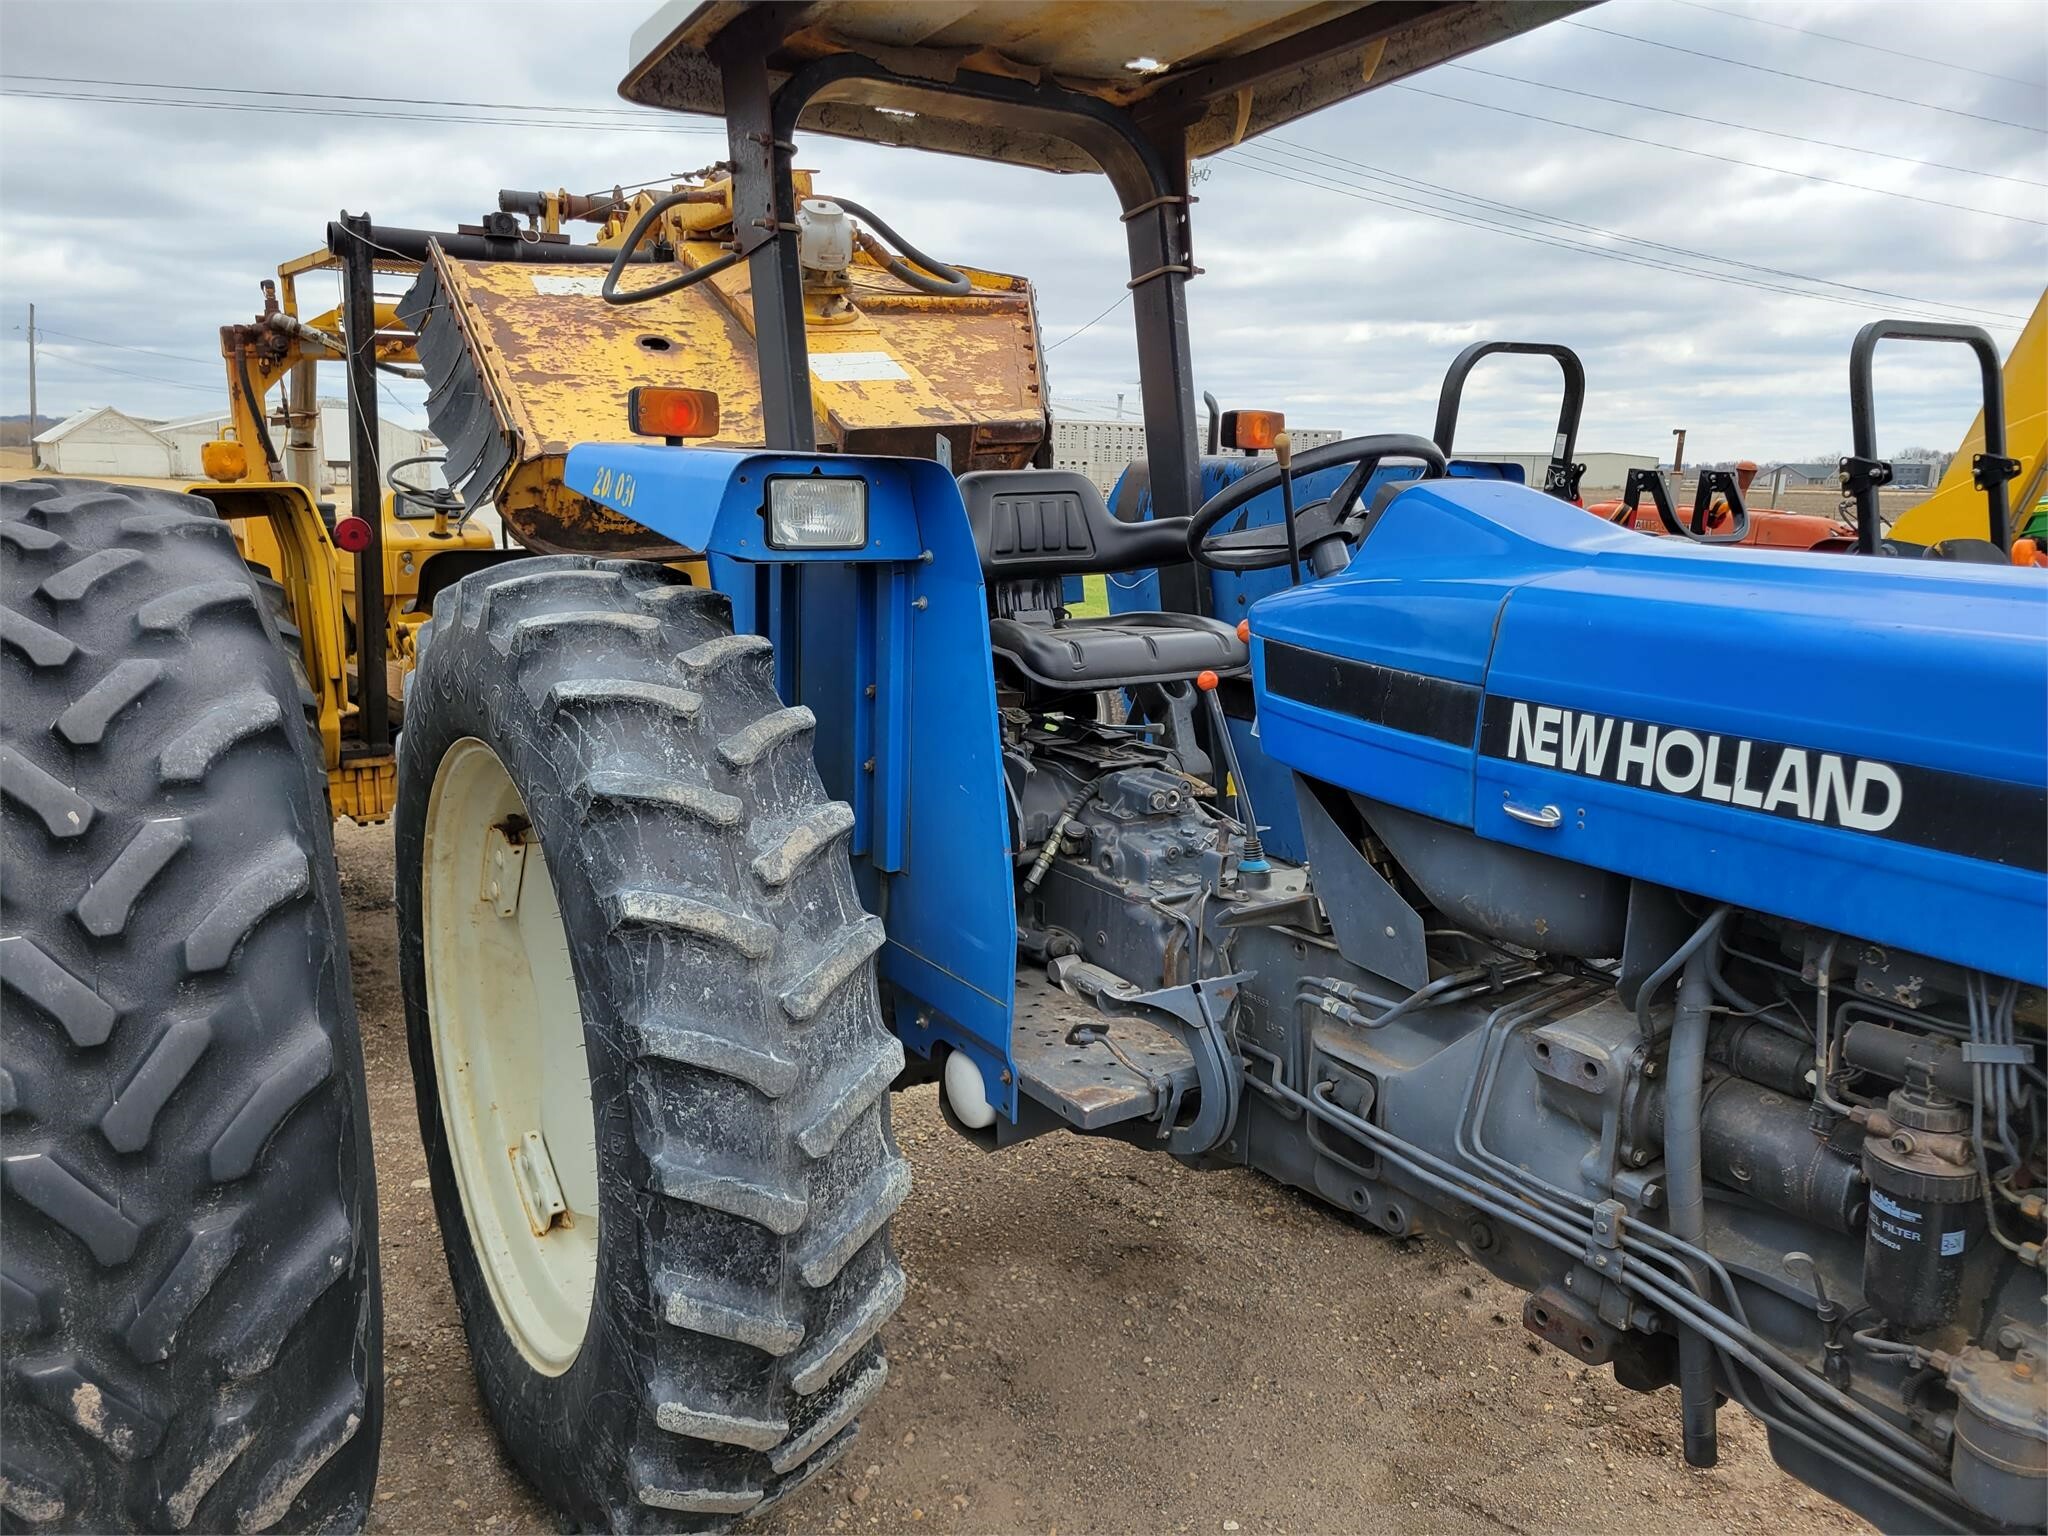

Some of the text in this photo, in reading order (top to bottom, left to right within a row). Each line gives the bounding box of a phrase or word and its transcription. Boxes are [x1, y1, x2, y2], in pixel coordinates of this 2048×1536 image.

[1507, 702, 1904, 832] NEW HOLLAND
[1881, 1220, 1921, 1242] FILTER
